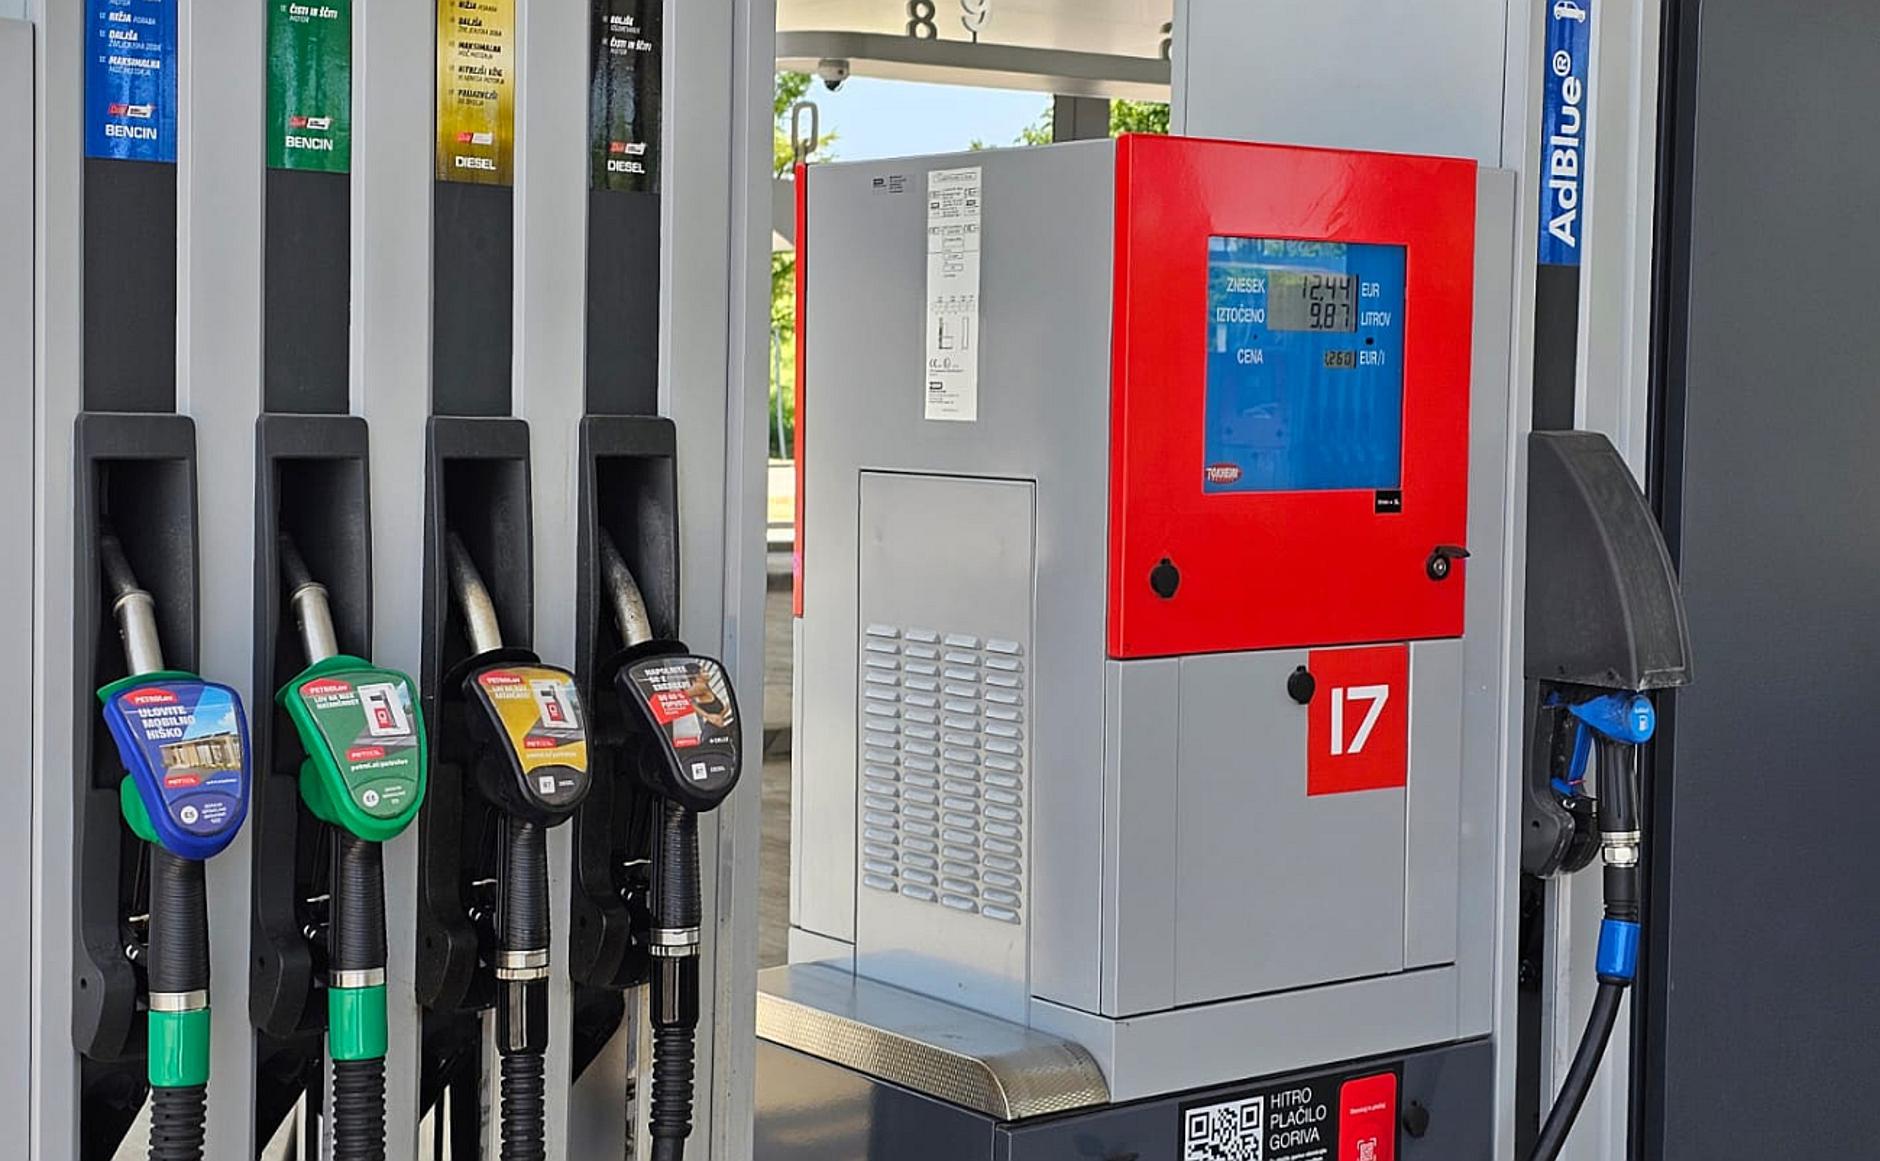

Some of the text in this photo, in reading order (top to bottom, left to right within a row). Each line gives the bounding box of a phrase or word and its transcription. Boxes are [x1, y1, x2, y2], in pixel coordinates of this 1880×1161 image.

[907, 0, 937, 39] 8
[105, 124, 157, 140] BENCIN
[285, 135, 333, 151] BENCIN
[456, 156, 496, 170] DIESEL
[608, 160, 645, 174] DIESEL
[1227, 277, 1265, 294] ZNESEK
[1361, 283, 1379, 298] EUR
[1216, 304, 1264, 323] IZTOČENO
[1361, 312, 1391, 327] LITROV
[1237, 349, 1263, 364] CENA
[138, 705, 187, 718] ULOVITE
[1330, 684, 1390, 755] 17
[142, 715, 195, 729] MOBILNO
[146, 727, 182, 740] HIŠKO
[1270, 1086, 1312, 1109] HITRO
[1270, 1104, 1327, 1130] PLAČILO
[1269, 1127, 1321, 1150] GORIVA
